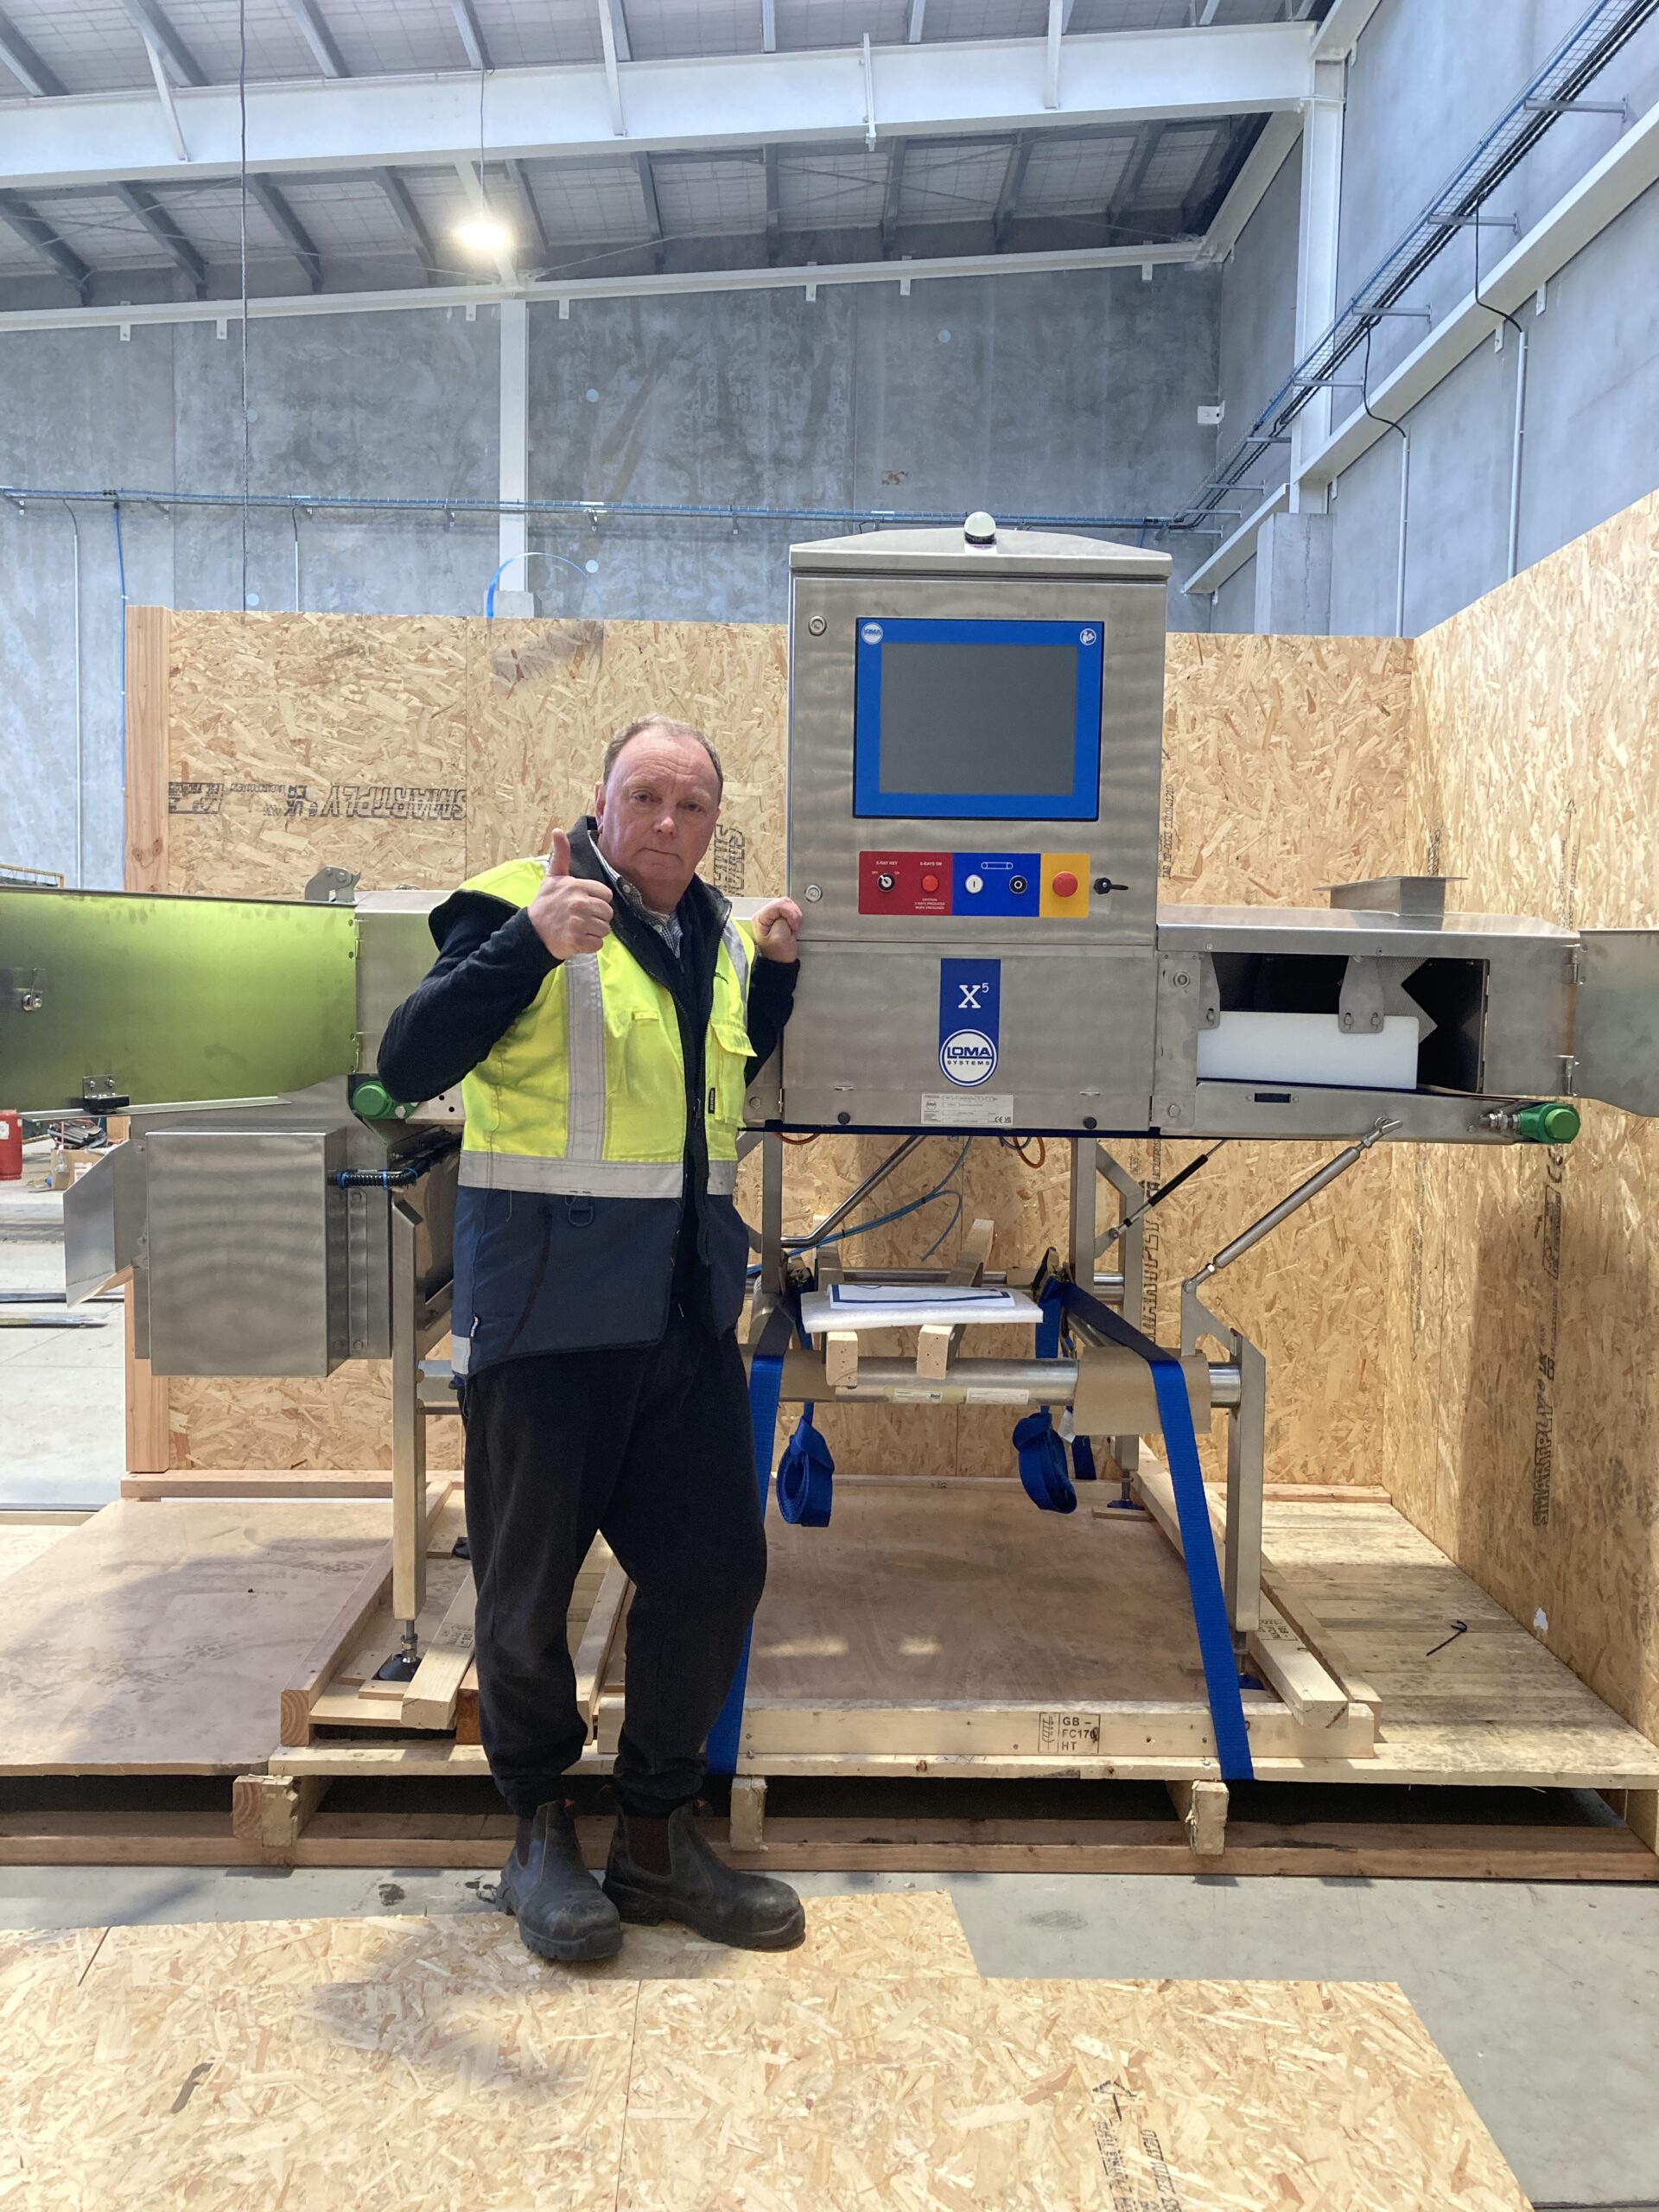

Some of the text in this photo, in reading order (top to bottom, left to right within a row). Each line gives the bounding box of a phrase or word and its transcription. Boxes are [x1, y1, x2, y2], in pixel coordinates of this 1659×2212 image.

[321, 785, 467, 820] SMARTPLY
[947, 1046, 993, 1059] LOMA
[1533, 1392, 1554, 1526] SMARTPLY
[1062, 1717, 1080, 1726] GB
[1061, 1741, 1077, 1751] HT
